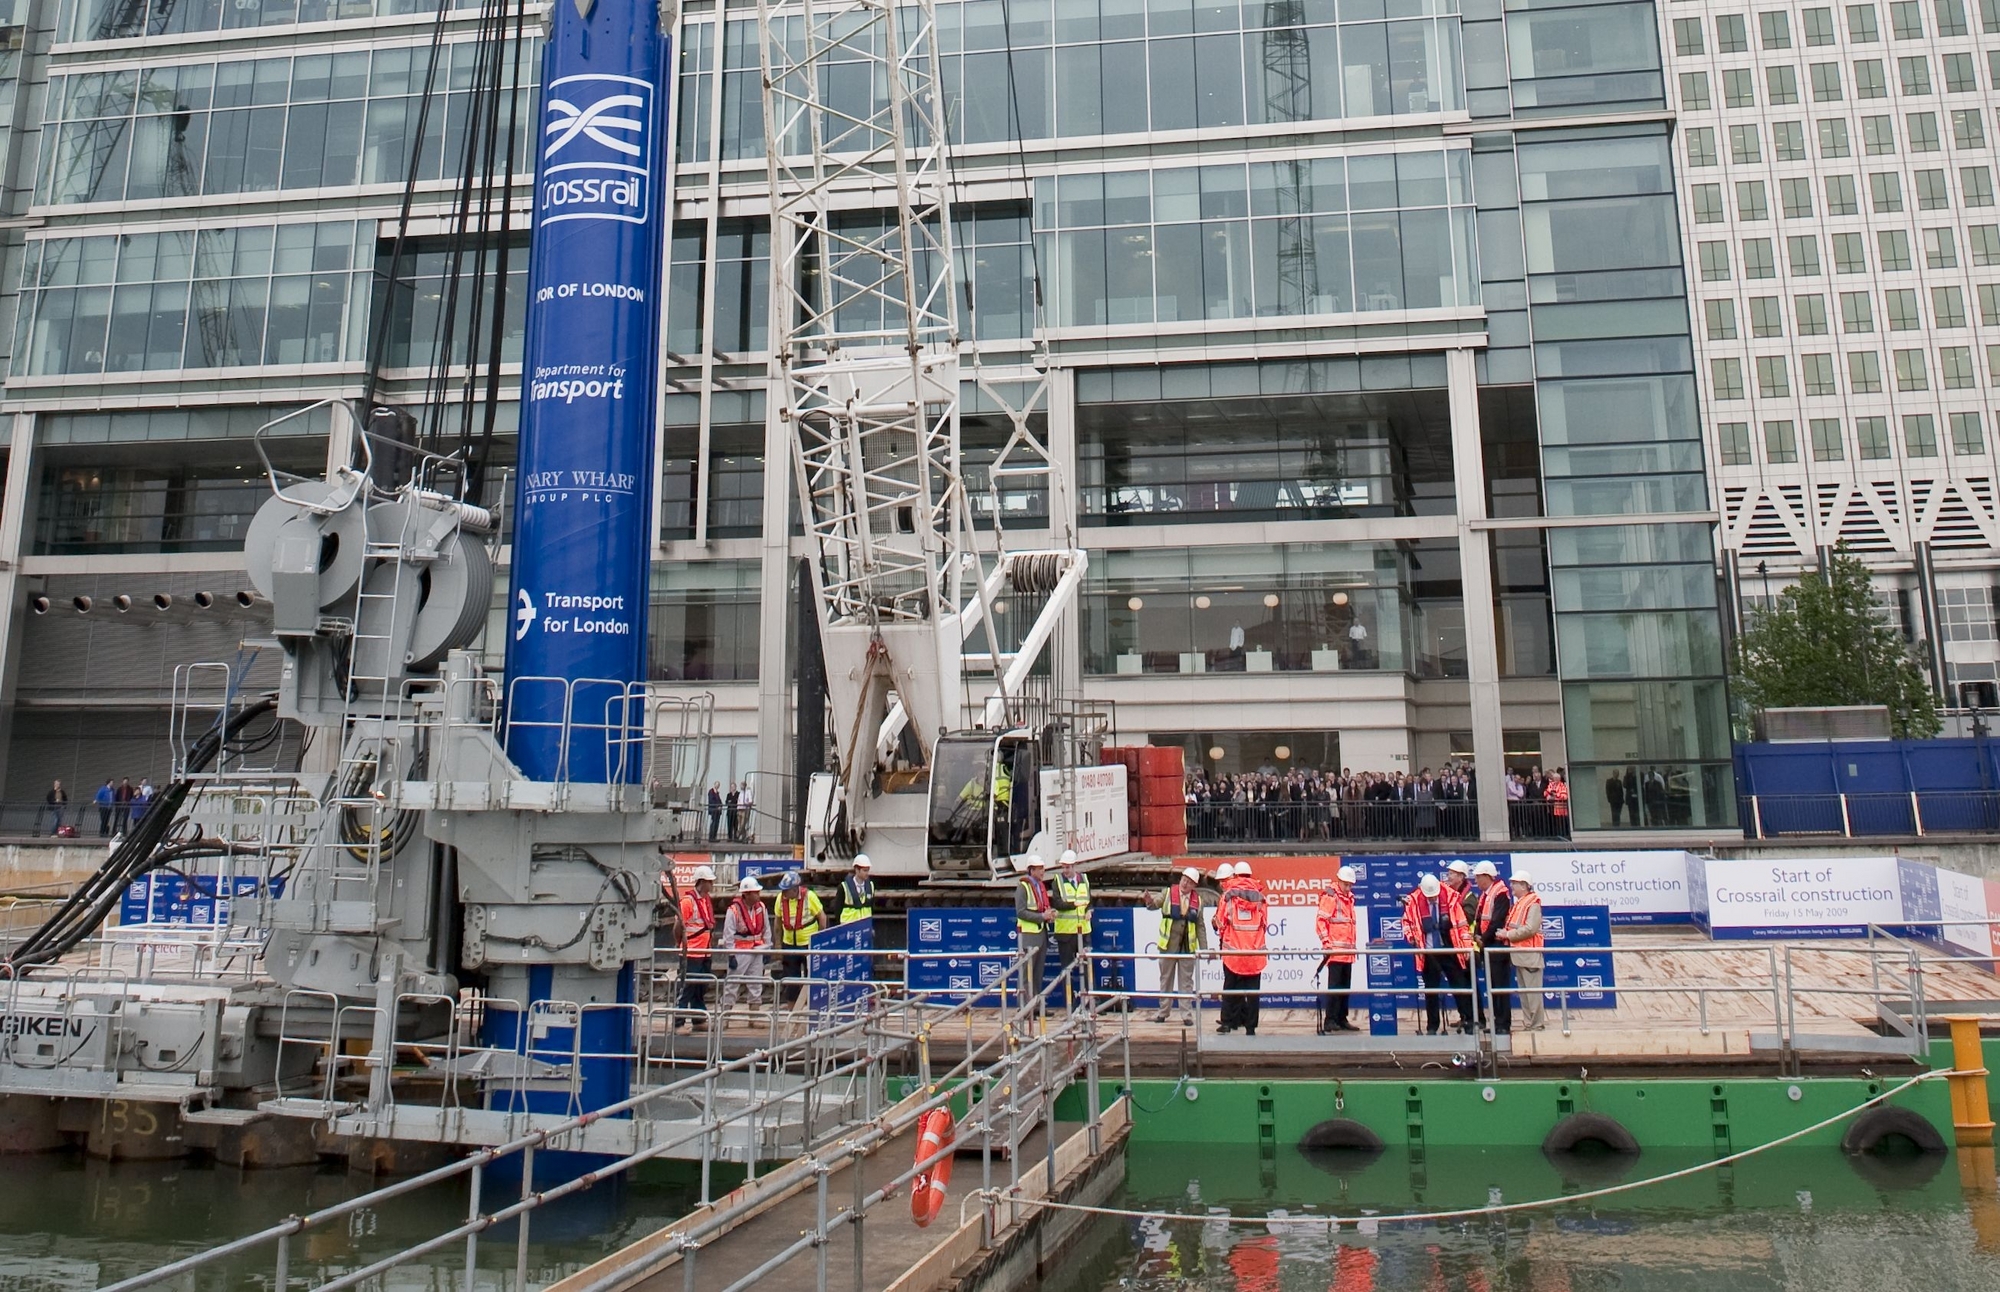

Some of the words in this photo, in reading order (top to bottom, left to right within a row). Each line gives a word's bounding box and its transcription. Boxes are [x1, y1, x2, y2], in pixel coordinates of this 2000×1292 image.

[557, 283, 578, 298] OF
[582, 283, 644, 302] LONDON
[535, 364, 605, 380] Department
[608, 365, 627, 377] for
[530, 379, 624, 404] Transport
[572, 471, 635, 490] WHARF
[582, 493, 613, 503] PLC
[545, 592, 624, 611] Transport
[543, 616, 569, 633] for
[573, 616, 630, 635] London
[1571, 859, 1607, 875] Start
[1610, 859, 1626, 874] of
[1771, 867, 1811, 884] Start
[1815, 867, 1833, 883] of
[1266, 879, 1332, 891] WHARF
[1532, 877, 1584, 892] rossrail
[1587, 876, 1681, 892] construction
[1266, 893, 1320, 906] CTOR
[1620, 896, 1640, 906] 2009
[1715, 887, 1786, 904] Crossrail
[1790, 886, 1894, 903] construction
[1764, 908, 1790, 919] Friday
[1793, 908, 1803, 918] 15
[1805, 908, 1824, 919] May
[1826, 907, 1849, 918] 2009
[1266, 918, 1287, 937] of
[1201, 969, 1225, 981] Frida
[1261, 972, 1273, 984] ay
[1276, 969, 1304, 981] 2009
[0, 1015, 82, 1037] GIKEN
